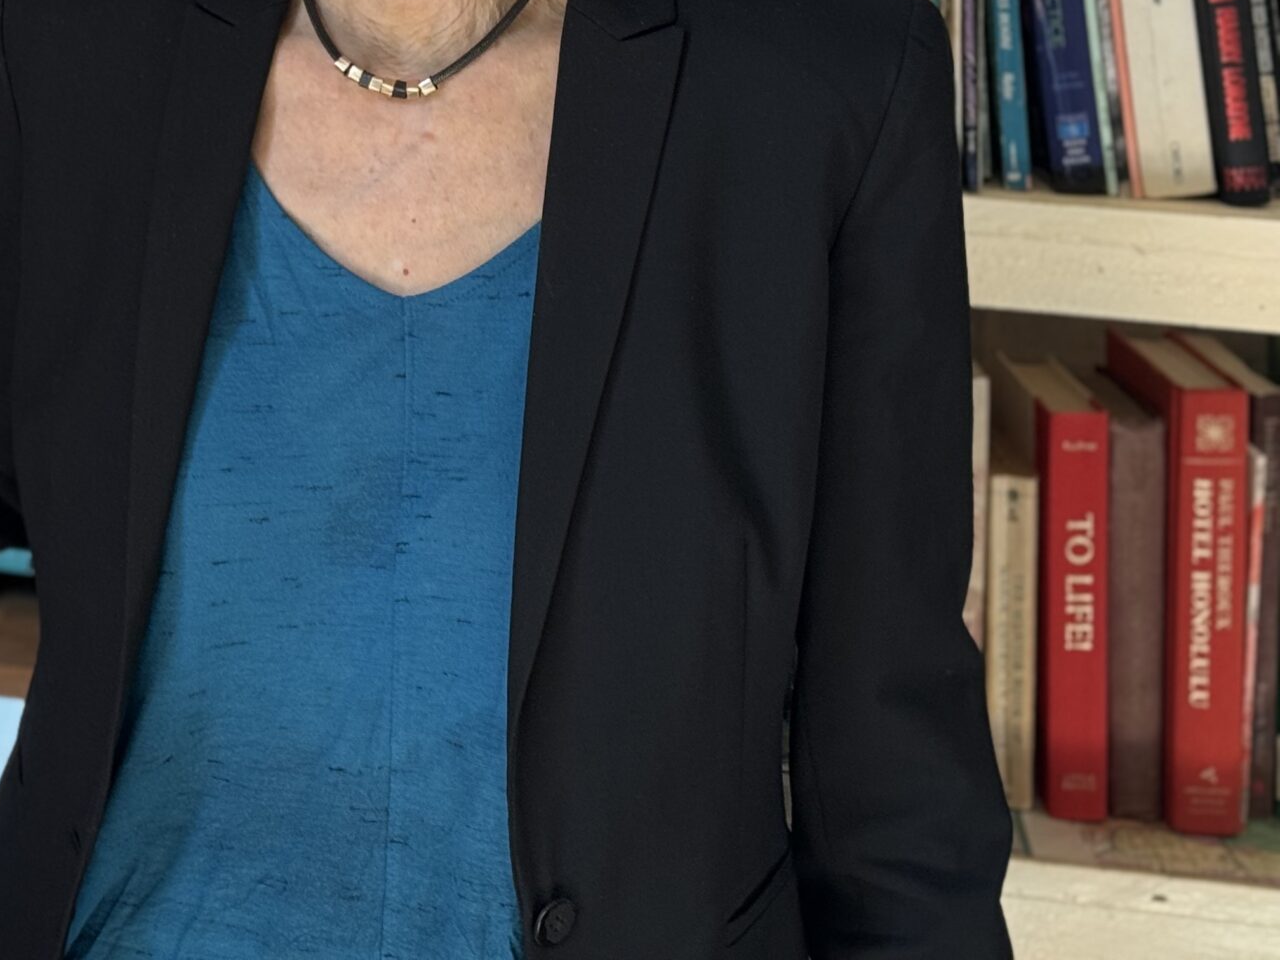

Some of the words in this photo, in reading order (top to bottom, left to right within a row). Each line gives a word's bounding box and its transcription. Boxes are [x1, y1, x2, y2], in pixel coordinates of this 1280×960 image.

[1064, 511, 1096, 564] TO
[1190, 478, 1217, 564] HOTEL
[1062, 573, 1094, 651] LIFE!
[1186, 569, 1214, 709] HONOLULU
